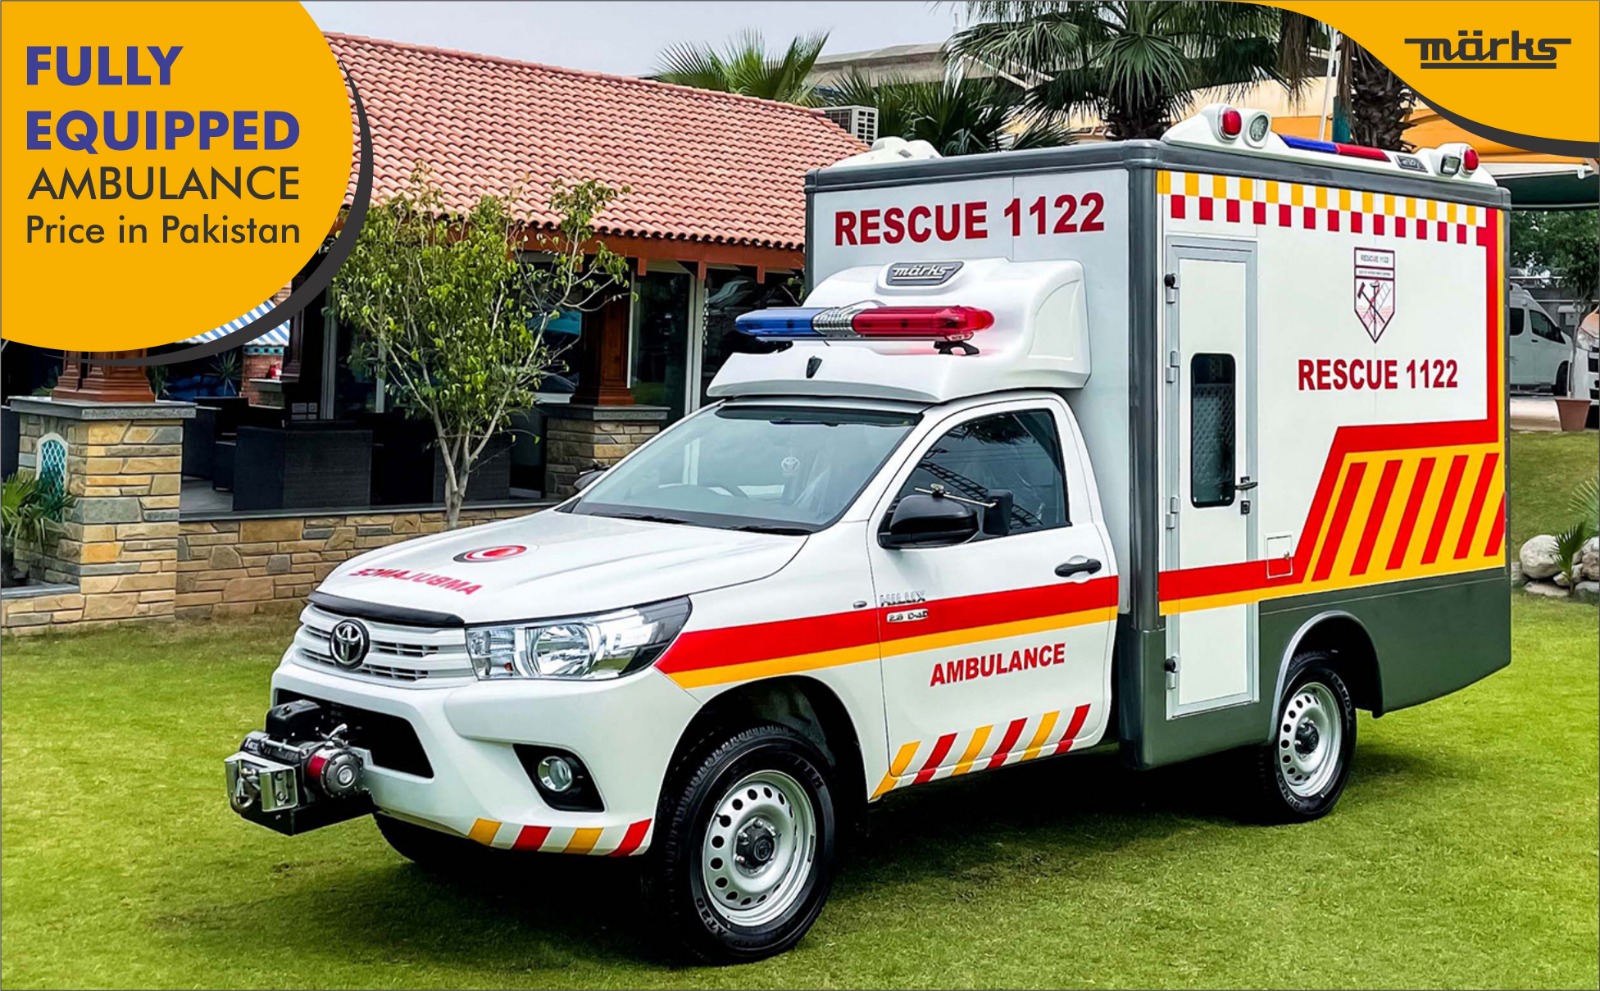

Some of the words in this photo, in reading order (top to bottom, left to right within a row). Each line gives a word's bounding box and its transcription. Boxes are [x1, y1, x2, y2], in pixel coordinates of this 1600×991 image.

[835, 201, 988, 246] RESCUE
[1004, 192, 1105, 237] 1122
[892, 264, 955, 279] märks
[1298, 359, 1398, 390] RESCUE
[1406, 359, 1458, 389] 1122
[930, 643, 1066, 687] AMBULANCE
